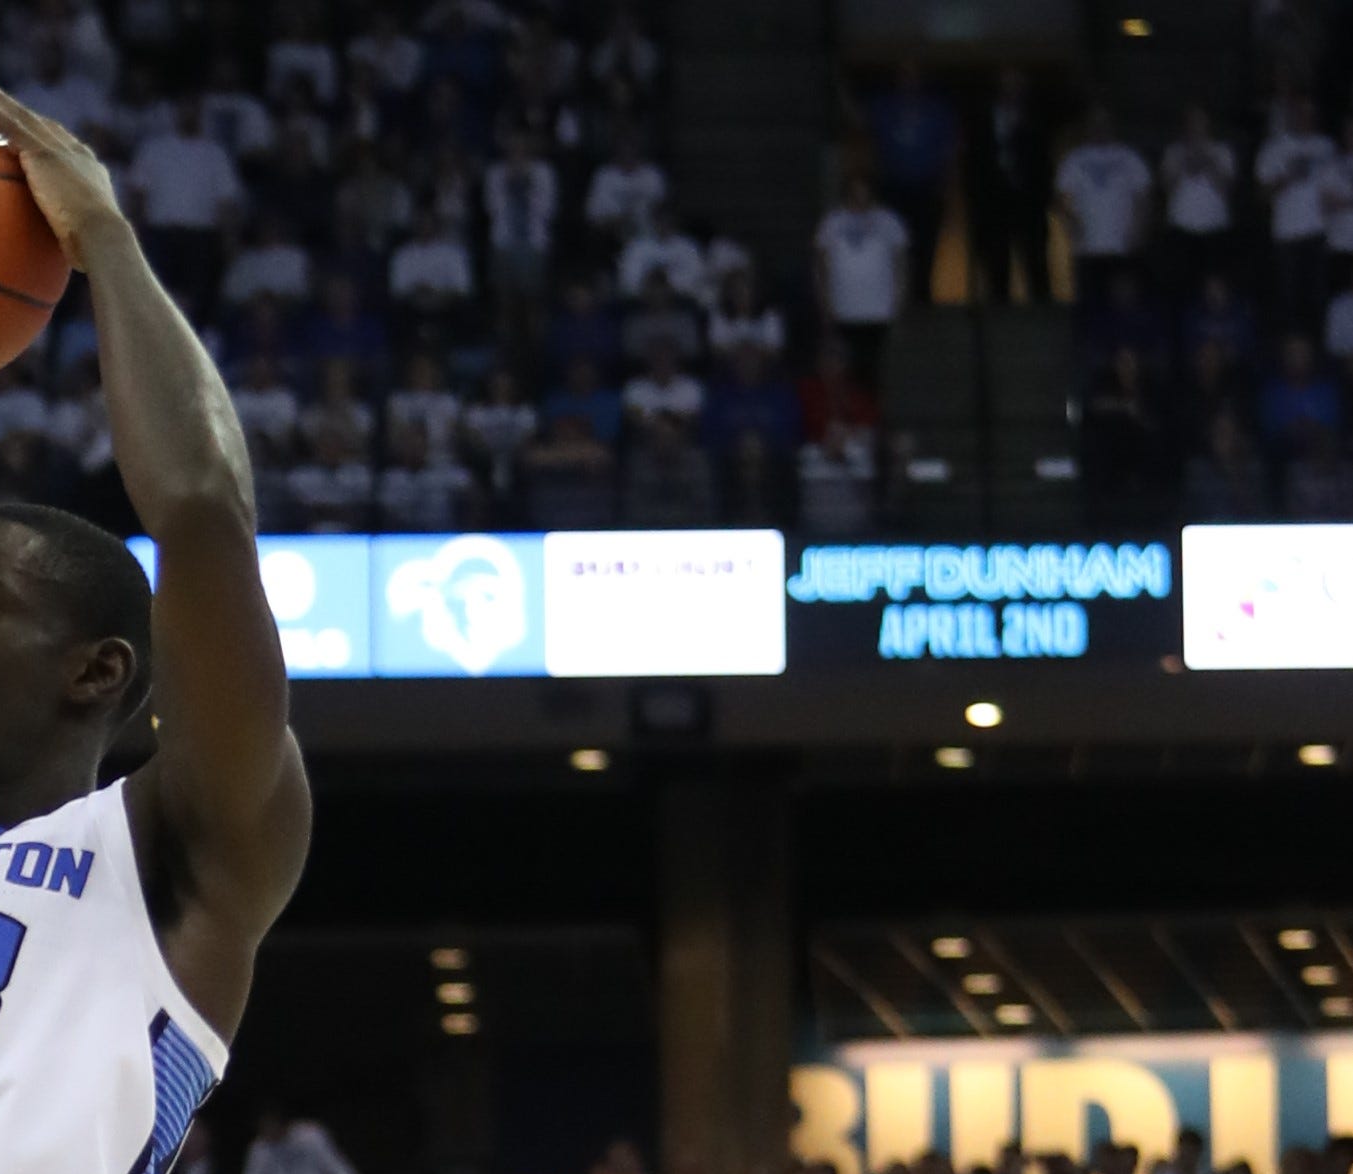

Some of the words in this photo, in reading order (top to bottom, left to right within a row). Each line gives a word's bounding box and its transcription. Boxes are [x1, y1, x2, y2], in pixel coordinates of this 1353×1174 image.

[787, 545, 925, 601] JEFF
[926, 543, 1171, 599] DUNHAM
[879, 603, 1001, 659] APRIL
[1002, 602, 1088, 658] 2ND
